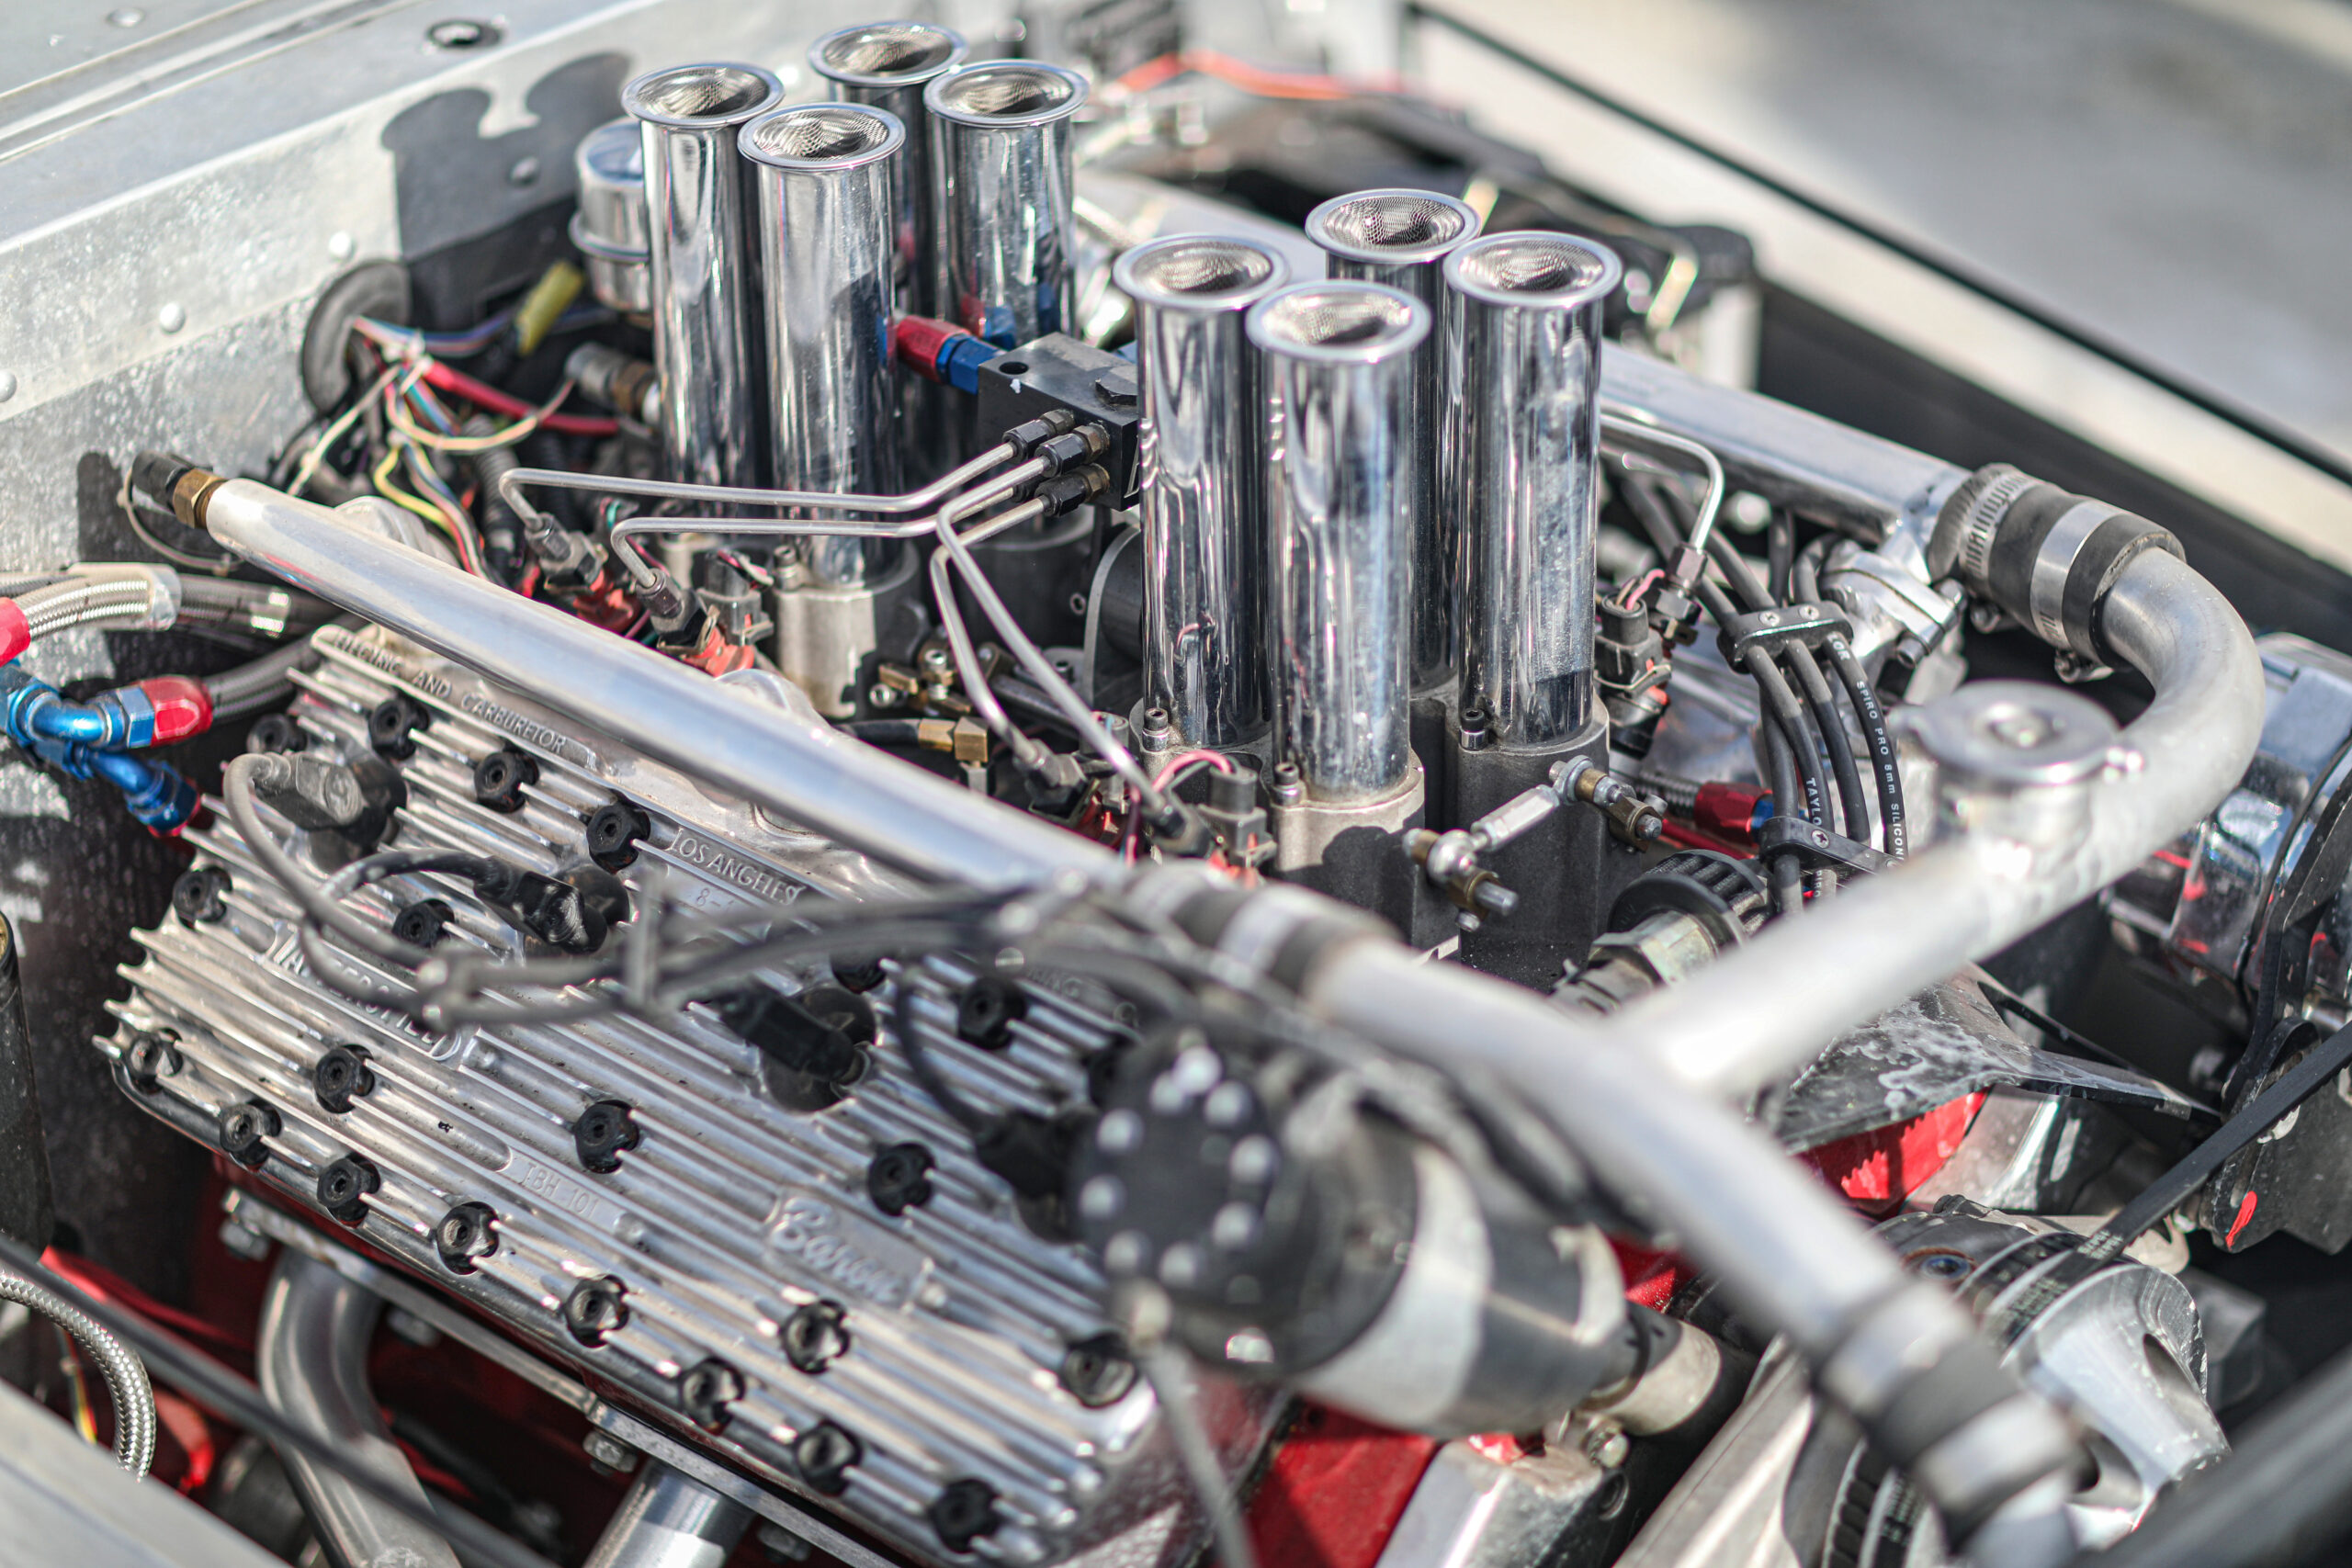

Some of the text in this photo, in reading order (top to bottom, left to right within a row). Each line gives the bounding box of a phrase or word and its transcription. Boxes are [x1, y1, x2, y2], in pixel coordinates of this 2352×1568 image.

[413, 670, 453, 699] AND
[461, 692, 568, 755] CARBURETOR
[1826, 633, 1851, 661] LOR
[1856, 680, 1878, 720] SPIRO
[1874, 727, 1889, 756] PRO
[1883, 763, 1896, 795] 8mm
[667, 827, 807, 907] LOS ANGELES
[1805, 776, 1824, 897] TAYLO PIRO
[568, 1187, 600, 1220] 101
